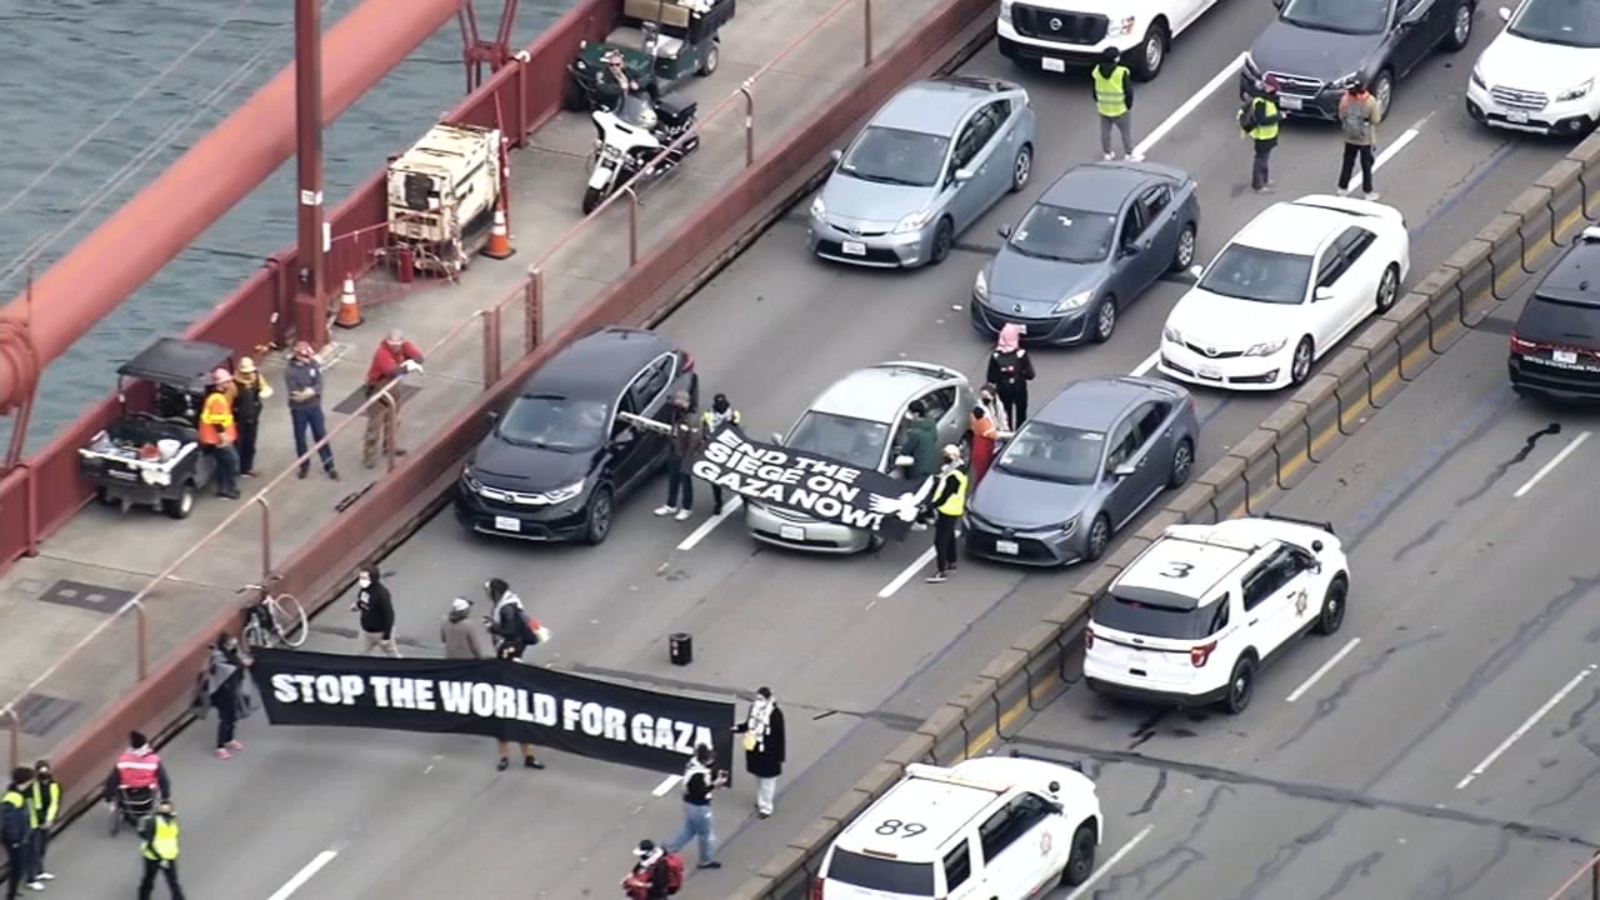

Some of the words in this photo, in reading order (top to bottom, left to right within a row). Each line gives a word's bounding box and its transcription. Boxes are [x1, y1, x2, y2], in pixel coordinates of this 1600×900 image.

[704, 442, 804, 484] SIEGE
[806, 475, 861, 502] ON
[717, 429, 788, 465] END
[795, 457, 861, 483] THE
[692, 460, 784, 502] GAZA
[788, 488, 884, 530] NOW!
[1160, 561, 1194, 579] 3
[271, 673, 364, 705] STOP
[370, 676, 436, 710] THE
[439, 681, 557, 726] WORLD
[563, 699, 627, 741] FOR
[631, 713, 713, 754] GAZA
[875, 819, 927, 838] 89
